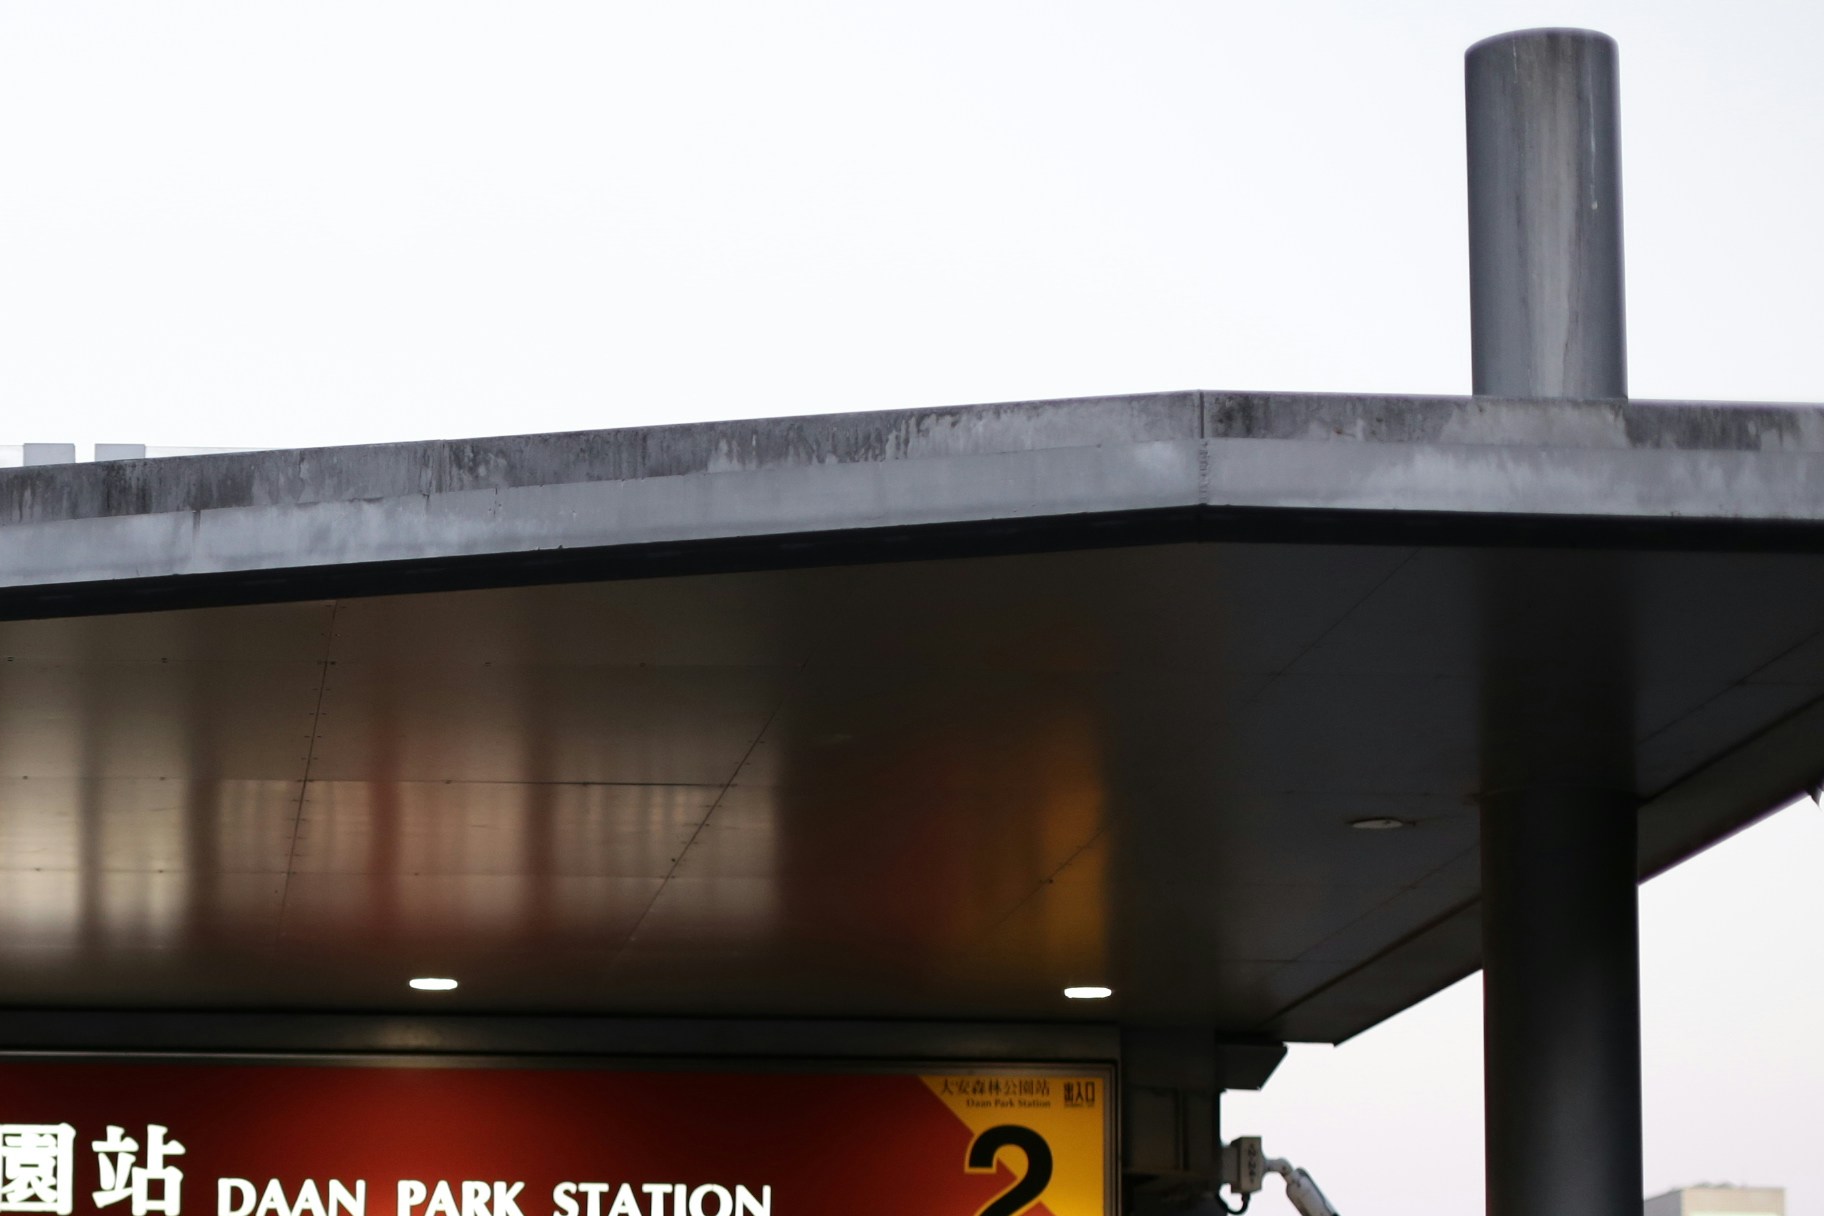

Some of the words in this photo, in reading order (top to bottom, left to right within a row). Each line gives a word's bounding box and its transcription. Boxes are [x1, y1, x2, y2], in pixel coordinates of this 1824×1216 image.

[941, 1078, 1050, 1097] 大安森林公園站
[1063, 1080, 1096, 1104] 出入口
[966, 1098, 992, 1108] Daan
[995, 1098, 1015, 1108] Park
[1018, 1099, 1051, 1109] Station
